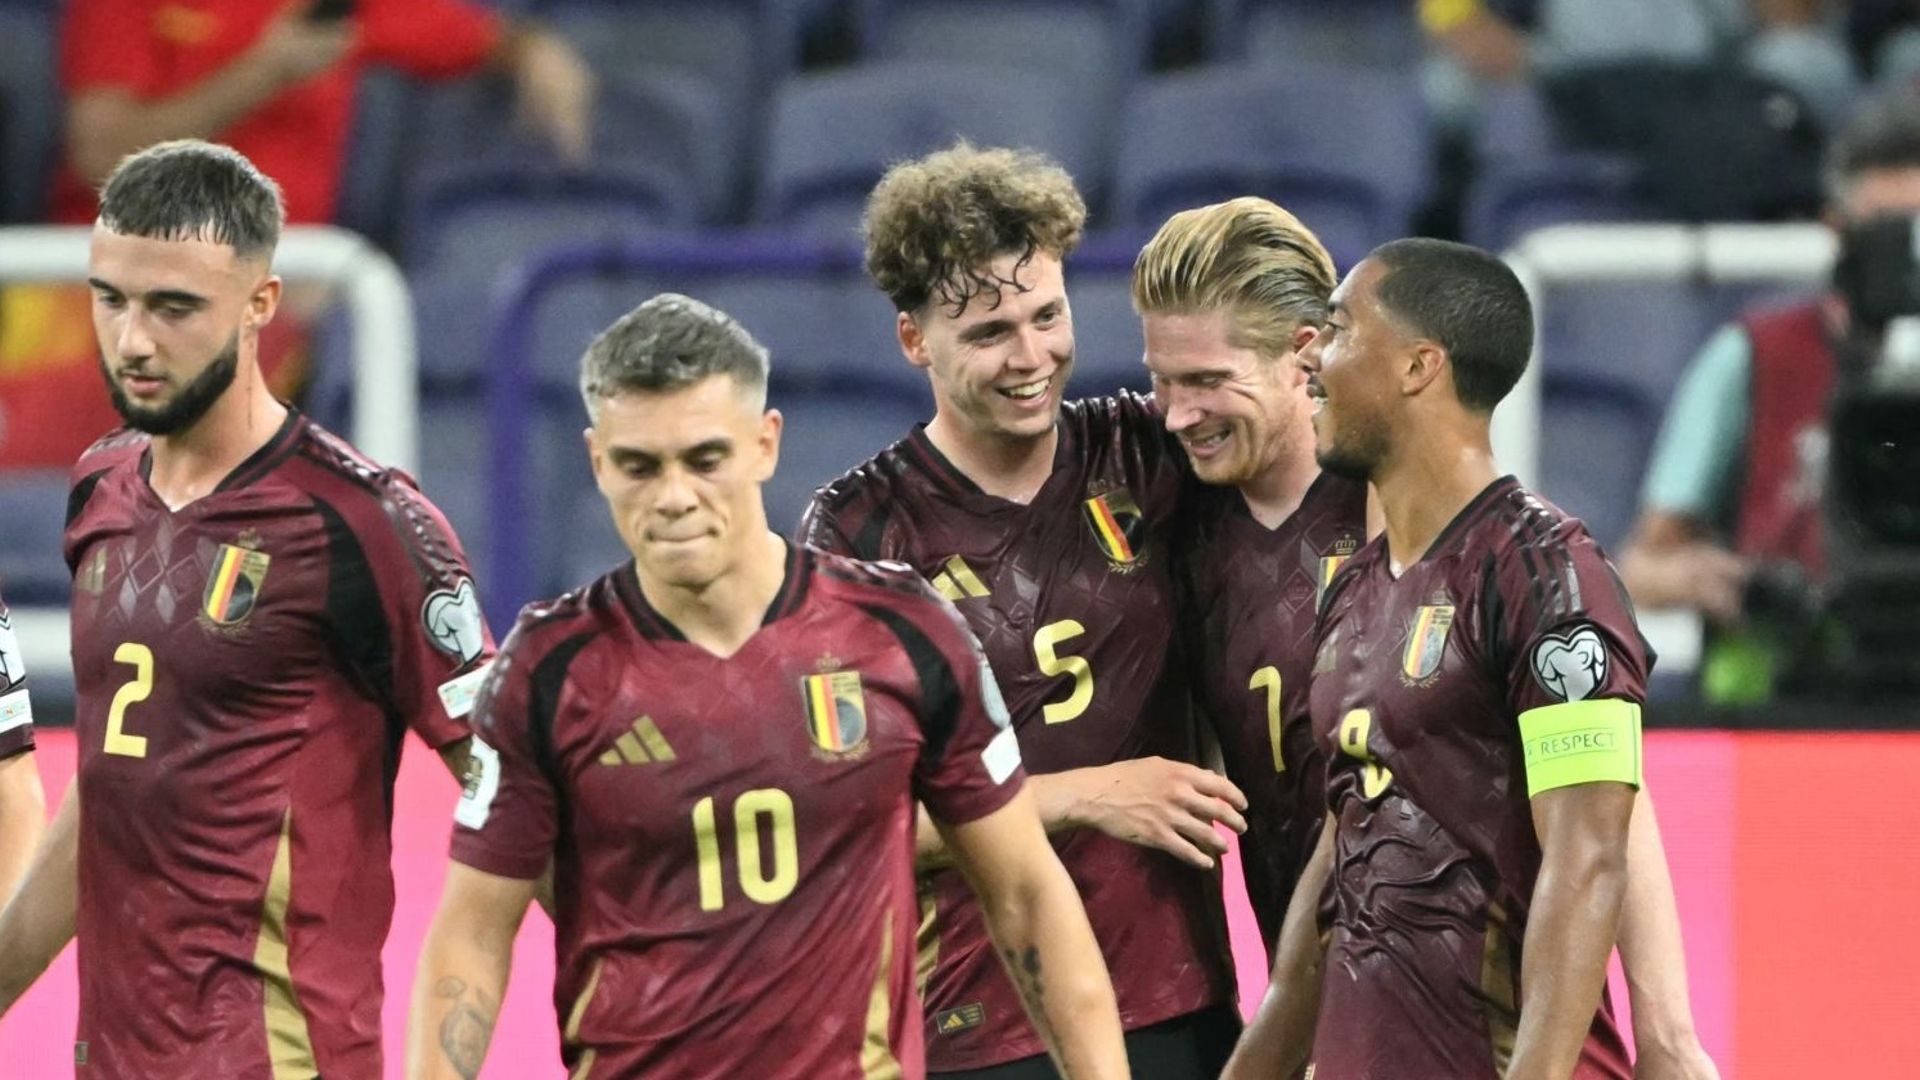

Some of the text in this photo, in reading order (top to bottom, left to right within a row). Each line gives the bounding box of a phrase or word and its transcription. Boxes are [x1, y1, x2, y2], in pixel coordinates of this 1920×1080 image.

[103, 642, 154, 758] 2
[1033, 618, 1094, 725] 5
[1249, 665, 1286, 773] 7
[1541, 732, 1615, 755] RESPECT
[692, 788, 799, 911] 10
